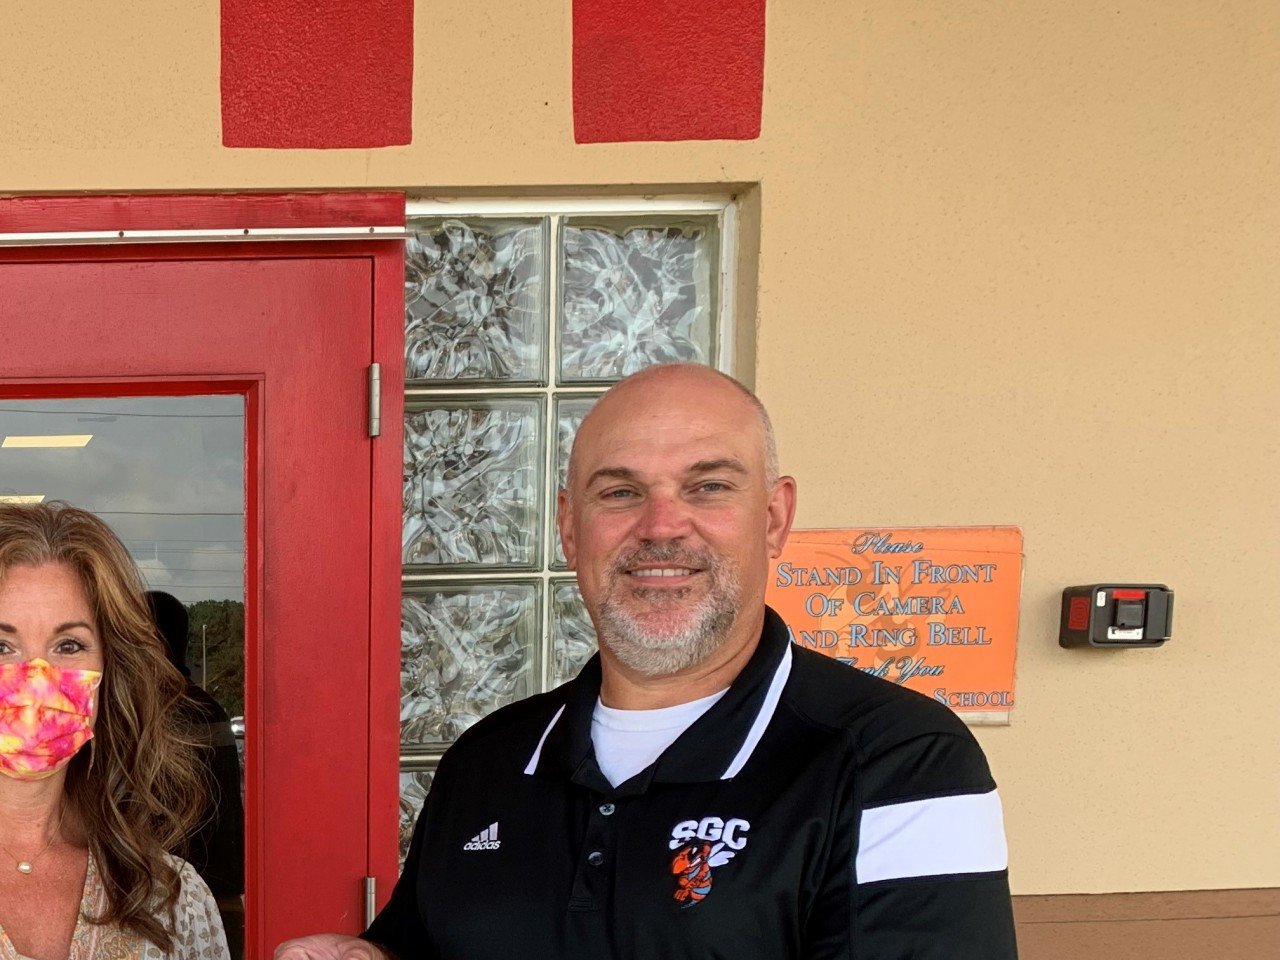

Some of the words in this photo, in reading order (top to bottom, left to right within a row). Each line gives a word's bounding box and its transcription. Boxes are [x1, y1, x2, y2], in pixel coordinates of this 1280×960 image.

[851, 531, 924, 554] Please
[776, 561, 862, 588] STAND
[912, 559, 997, 584] FRONT
[854, 591, 965, 616] CAMERA
[848, 623, 918, 648] RING
[927, 621, 992, 647] BELL
[895, 656, 945, 684] You
[463, 840, 501, 851] adidas
[668, 816, 751, 850] SGC
